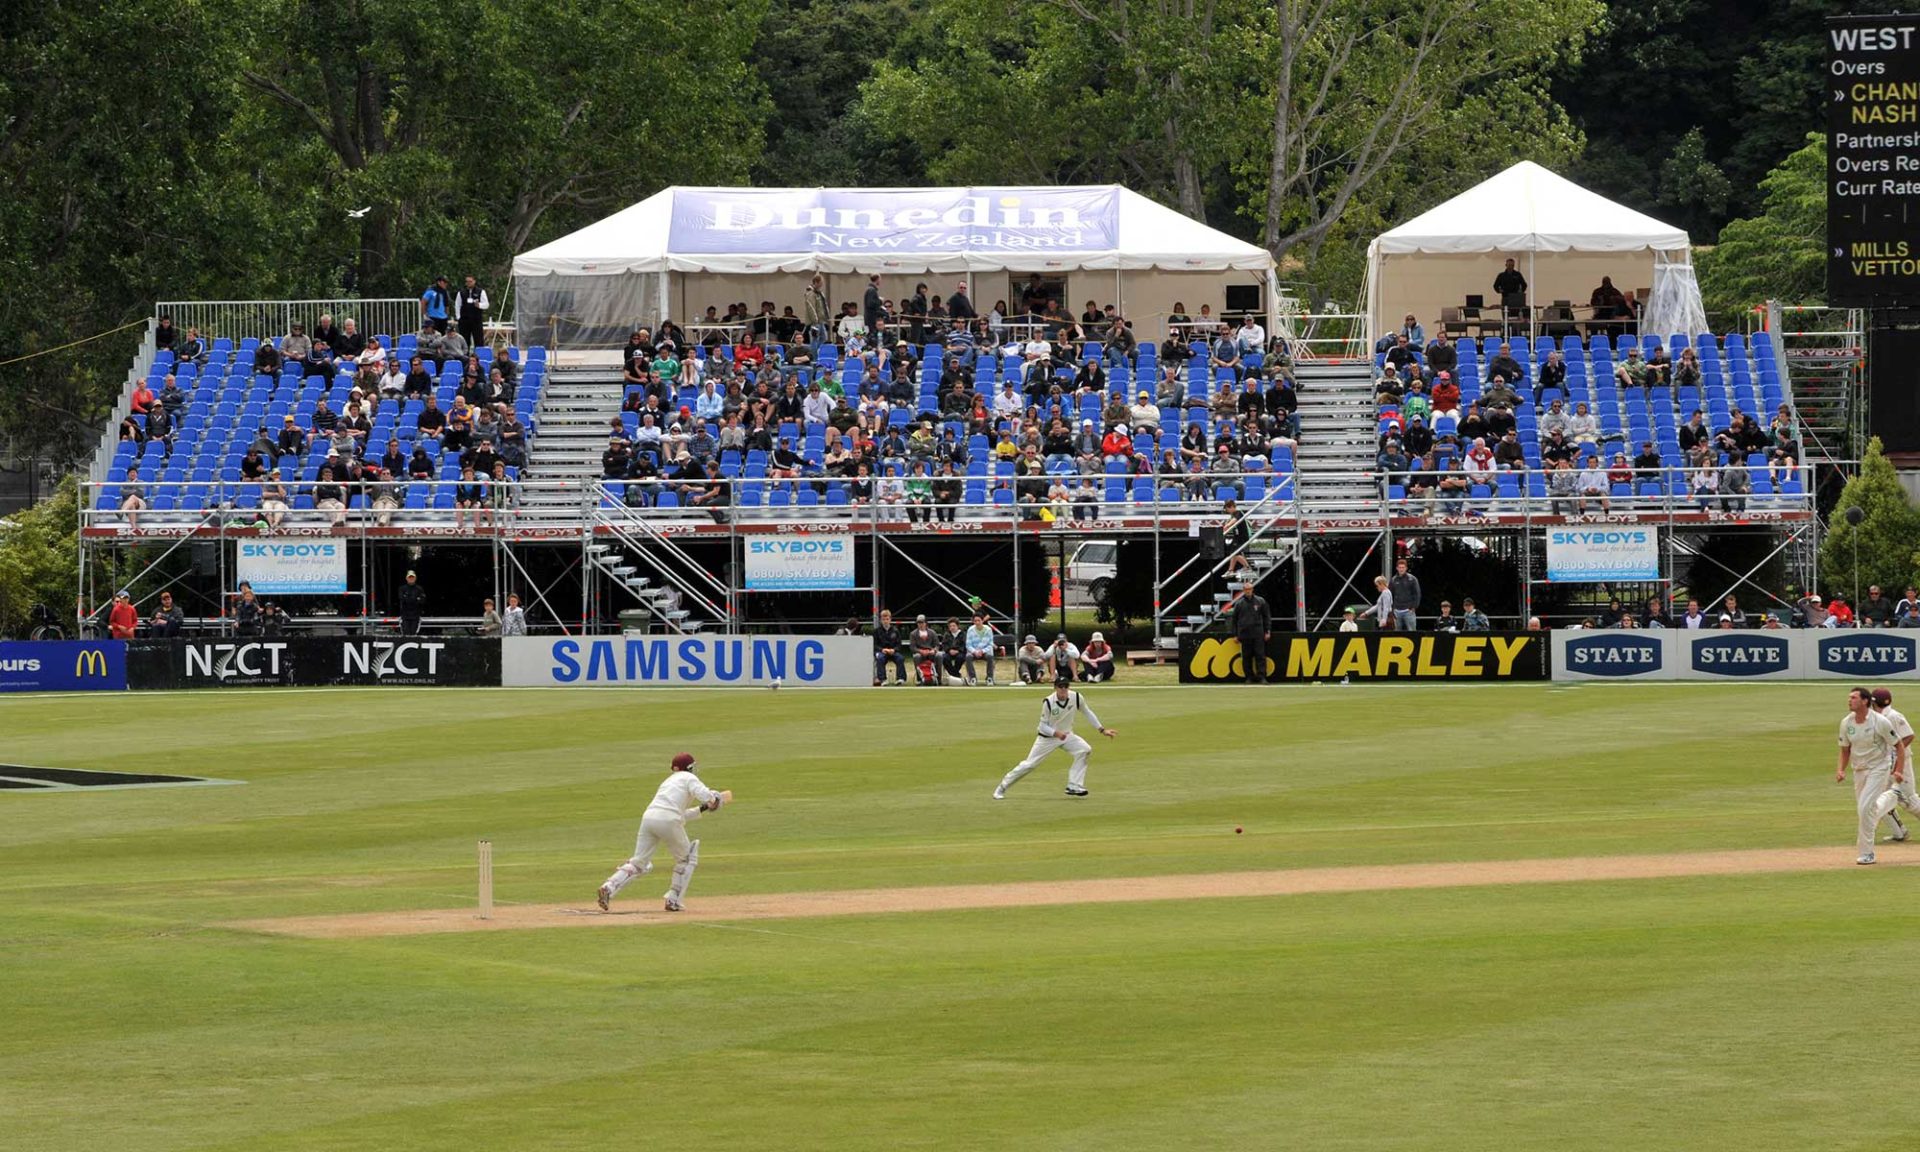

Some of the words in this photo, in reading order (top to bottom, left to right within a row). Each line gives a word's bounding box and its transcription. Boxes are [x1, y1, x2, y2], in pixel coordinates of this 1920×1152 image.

[1831, 27, 1915, 51] WEST
[1831, 60, 1885, 75] Overs
[1851, 82, 1920, 101] CHAN
[1852, 104, 1916, 124] NASH
[1836, 157, 1889, 172] Overs
[1836, 181, 1875, 196] Curr
[1882, 179, 1920, 196] Rate
[706, 196, 1081, 231] Dunedin
[811, 232, 899, 249] New
[914, 229, 1084, 248] Zealand
[1852, 241, 1908, 257] MILLS
[1786, 349, 1855, 357] SKYBOYS
[1426, 516, 1500, 524] SKYBOYS
[1565, 515, 1638, 523] SKYBOYS
[1708, 511, 1782, 520] SKYBOYS
[777, 523, 849, 531] SKYBOYS
[910, 522, 983, 530] SKYBOYS
[1052, 520, 1124, 528] SKYBOYS
[1307, 519, 1380, 527] SKYBOYS
[117, 528, 190, 536] SKYBOYS
[259, 527, 332, 535] SKYBOYS
[403, 527, 475, 535] SKYBOYS
[504, 528, 577, 536] SKYBOYS
[1552, 532, 1647, 544] SKYBOYS
[242, 544, 336, 556] SKYBOYS
[751, 541, 843, 553] SKYBOYS
[1556, 561, 1585, 569] 0800
[1590, 560, 1650, 569] SKYBOYS
[245, 573, 274, 581] 0800
[279, 573, 338, 581] SKYBOYS
[753, 569, 782, 578] 0800
[787, 568, 847, 578] SKYBOYS
[343, 641, 445, 679] NZCT
[551, 639, 824, 682] SAMSUNG
[1285, 636, 1532, 677] MARLEY
[1574, 647, 1653, 663] STATE
[1701, 647, 1781, 663] STATE
[1827, 647, 1908, 662] STATE
[0, 659, 41, 671] urs
[185, 642, 287, 680] NZCT
